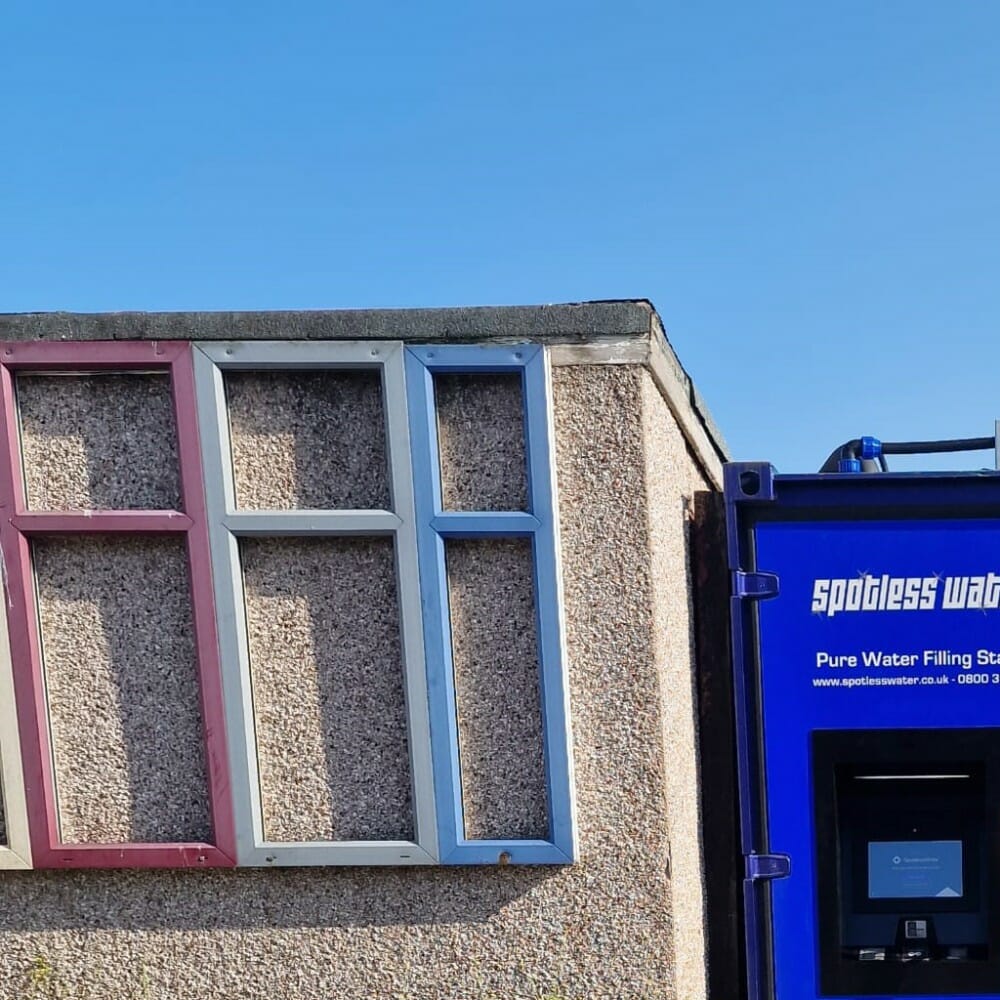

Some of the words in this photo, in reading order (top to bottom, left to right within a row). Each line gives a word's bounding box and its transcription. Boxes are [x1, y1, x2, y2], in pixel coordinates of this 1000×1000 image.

[811, 574, 939, 616] spotless
[816, 652, 857, 668] Pure
[862, 651, 919, 667] Water
[923, 650, 972, 669] Filling
[812, 673, 949, 688] www.spotlesswater.co.uk
[957, 673, 989, 685] 0800
